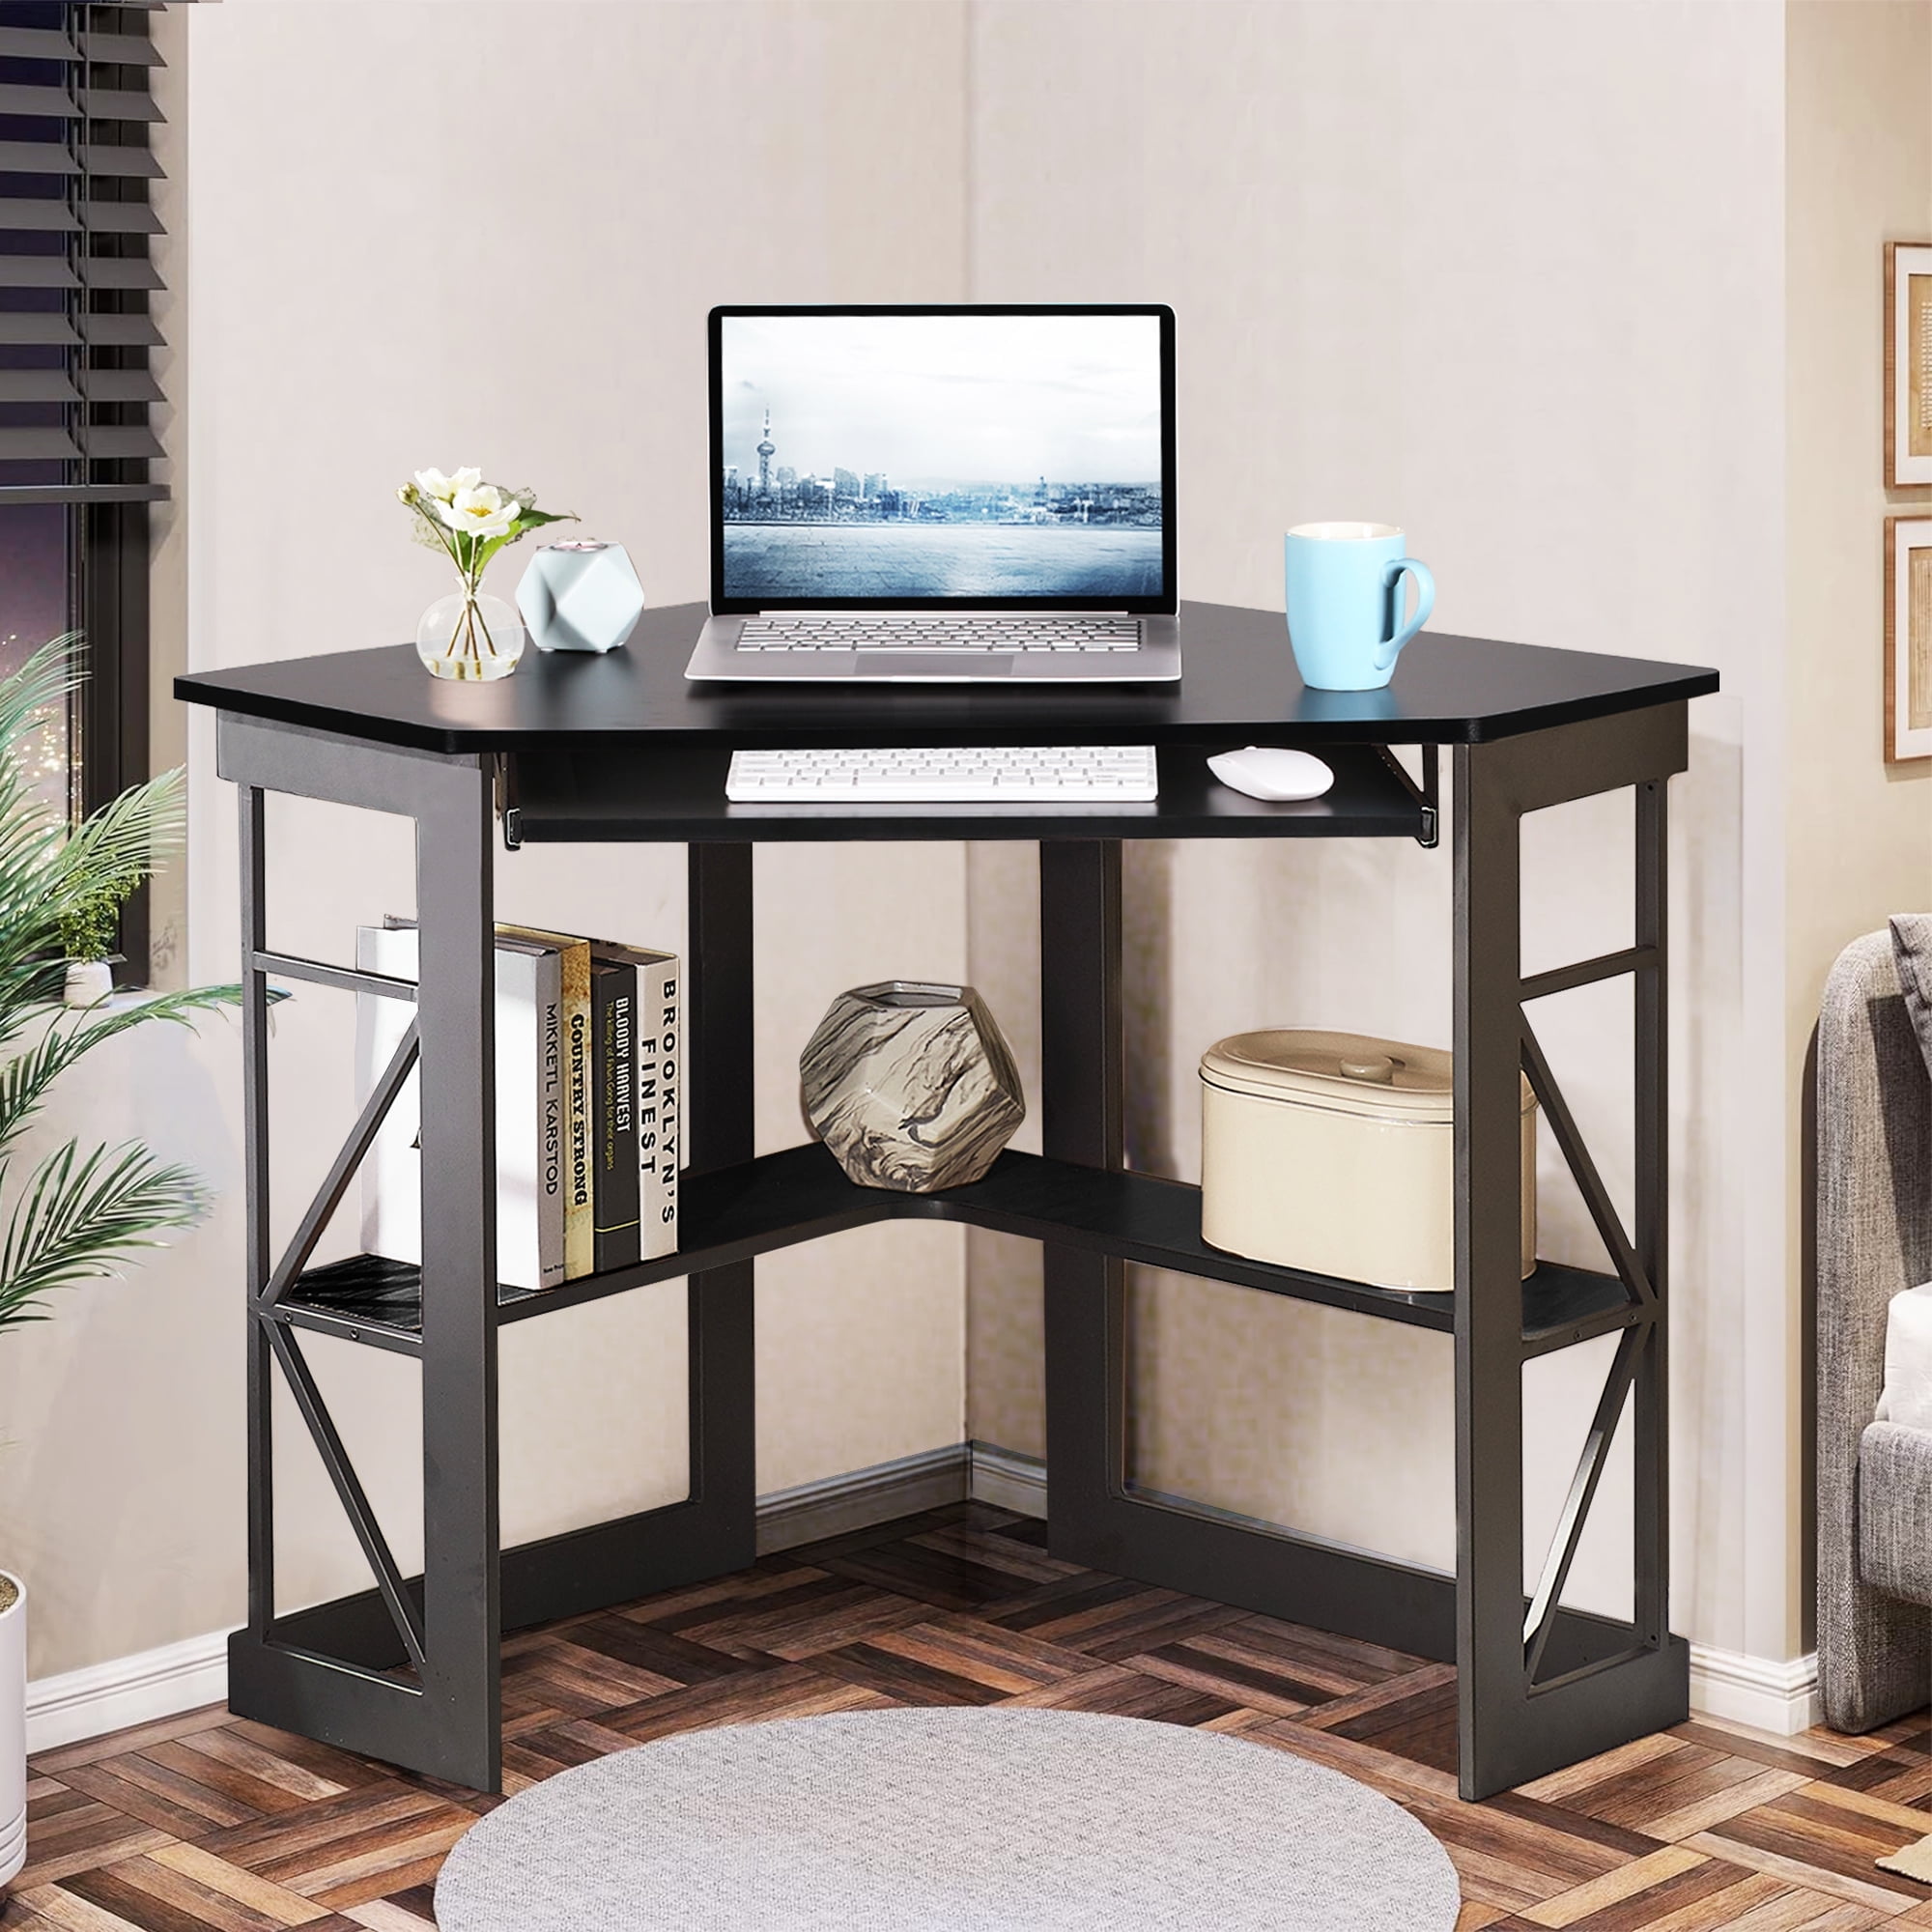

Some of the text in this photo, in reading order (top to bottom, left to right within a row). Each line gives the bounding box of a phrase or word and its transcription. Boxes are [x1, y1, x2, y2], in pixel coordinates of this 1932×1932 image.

[546, 1004, 558, 1195] MIKKETL KARSTOD
[571, 1013, 588, 1206] COUNTRY STRONG
[615, 997, 631, 1132] BLOODY HARVEST
[641, 1037, 657, 1174] FINEST
[663, 980, 676, 1223] BROOKLYN'S
